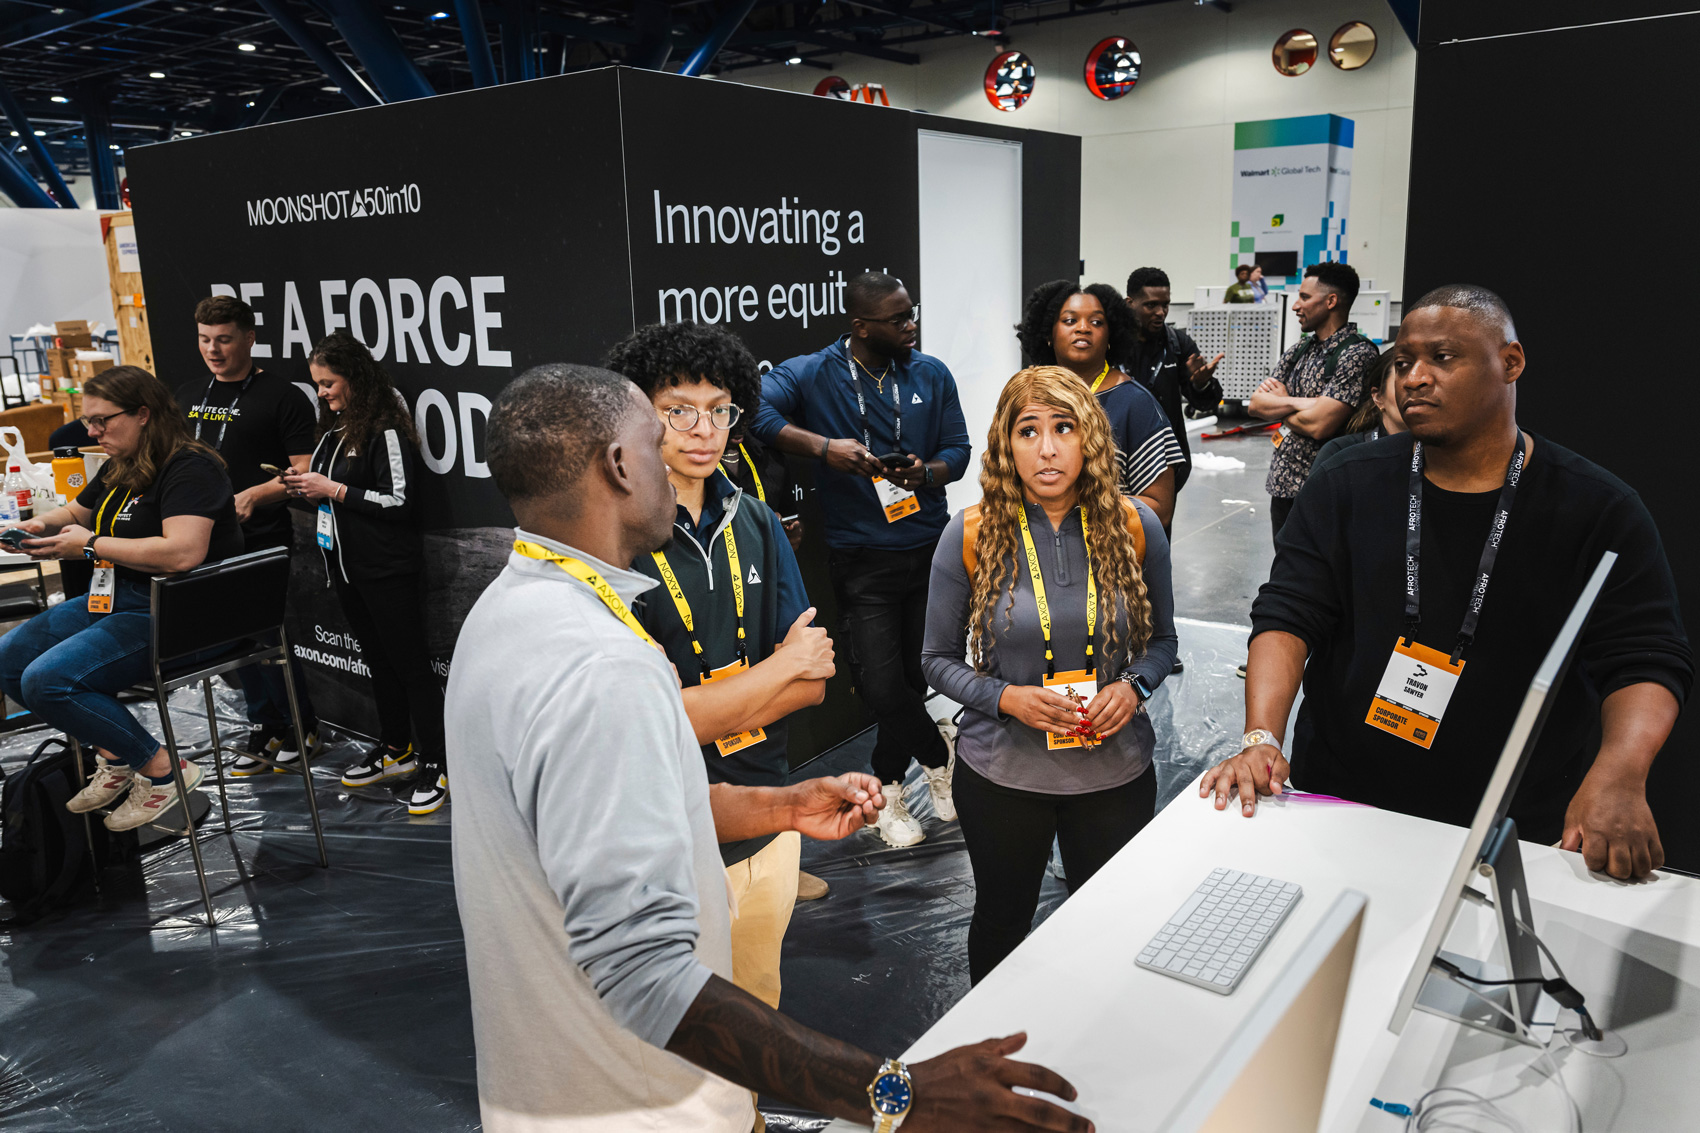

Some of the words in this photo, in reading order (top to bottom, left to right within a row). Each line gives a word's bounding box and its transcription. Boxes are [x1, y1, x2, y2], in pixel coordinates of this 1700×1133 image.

[1240, 169, 1270, 177] Walmart
[1281, 167, 1303, 175] Global
[1304, 165, 1321, 173] Tech
[653, 189, 841, 256] Innovating
[847, 210, 865, 244] a
[658, 285, 759, 326] more
[210, 282, 272, 358] E
[282, 281, 313, 359] A
[320, 275, 513, 368] FORCE
[187, 411, 210, 420] SAE
[191, 405, 217, 414] WITE
[1510, 450, 1525, 488] AFROTECH
[1018, 503, 1027, 524] AXO
[1408, 493, 1417, 532] AFROTECH
[1491, 509, 1509, 549] AFROTECH
[725, 530, 737, 559] AXON
[1026, 547, 1038, 572] AXON
[659, 562, 679, 591] AXON
[1407, 554, 1415, 597] AFROTECH
[597, 584, 628, 619] AXON
[1472, 572, 1490, 615] AFROTECH
[1037, 595, 1049, 621] AXON
[1088, 601, 1096, 627] AXON
[315, 624, 343, 648] Scan
[343, 633, 362, 653] the
[430, 657, 450, 677] visi
[1403, 686, 1424, 699] SAWYER
[1406, 677, 1428, 692] TRAVON
[1372, 714, 1399, 730] SPONSOR
[1375, 706, 1408, 726] CORPORATE
[722, 736, 742, 749] SPONSOR
[1053, 737, 1075, 745] SPONSOR
